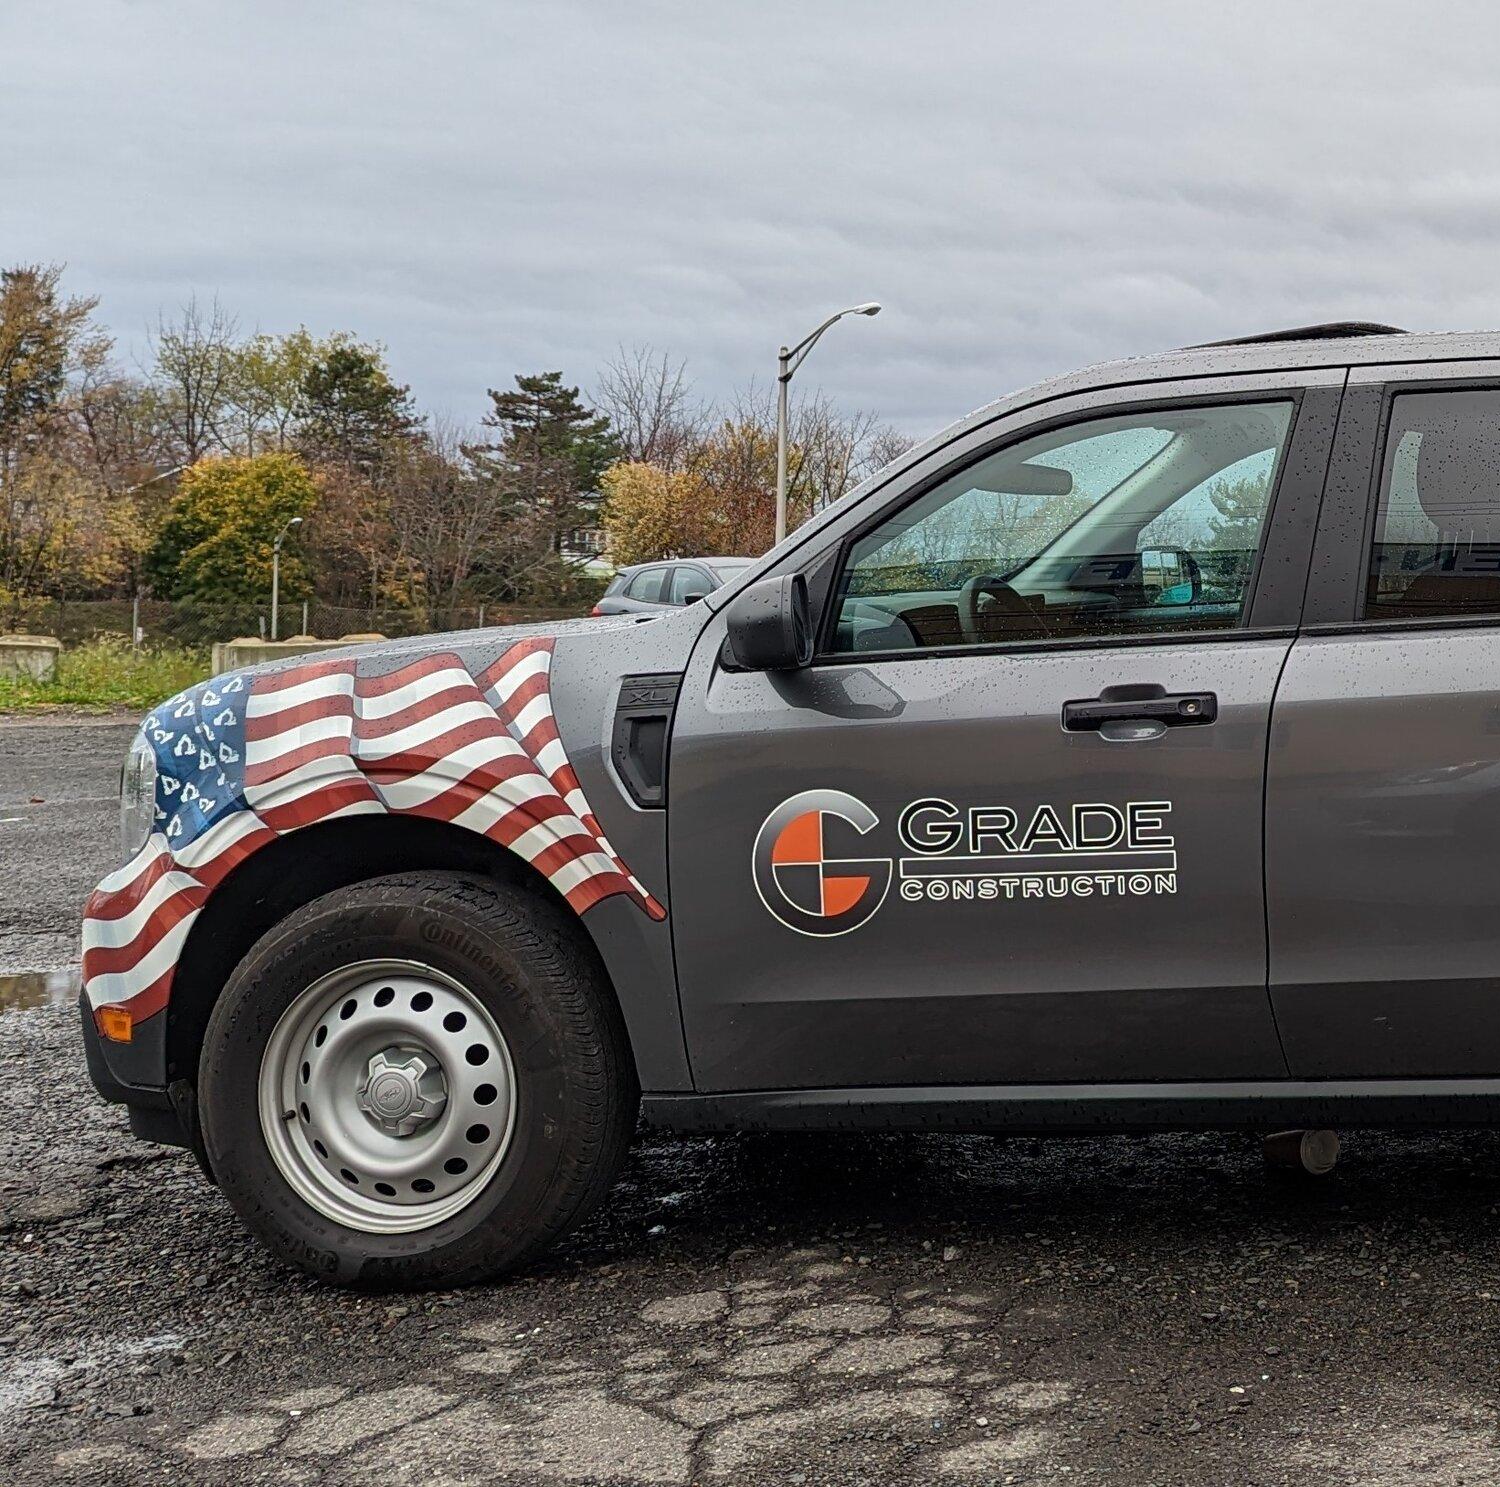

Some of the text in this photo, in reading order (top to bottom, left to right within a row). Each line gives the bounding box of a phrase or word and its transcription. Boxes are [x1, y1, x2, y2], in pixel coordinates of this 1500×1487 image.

[629, 690, 668, 704] XL
[898, 797, 1175, 855] GRADE
[899, 873, 1178, 901] CONSTRUCTION
